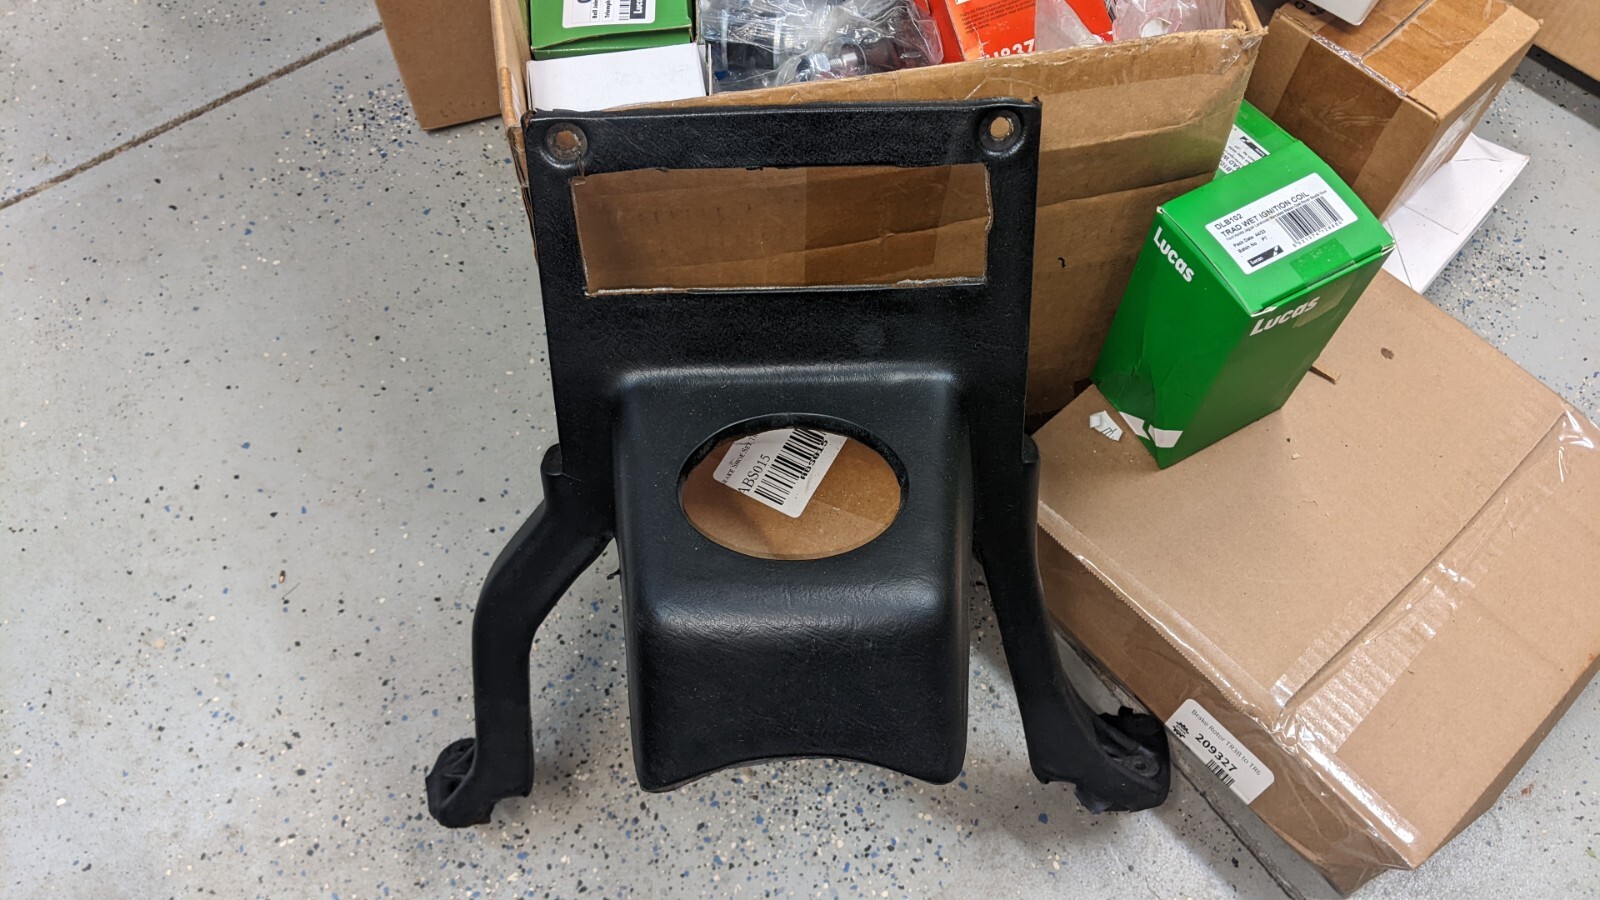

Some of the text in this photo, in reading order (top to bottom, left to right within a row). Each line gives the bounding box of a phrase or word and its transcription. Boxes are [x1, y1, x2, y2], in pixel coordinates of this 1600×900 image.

[1214, 214, 1243, 230] DLB102
[1221, 192, 1310, 238] TRAD WET IGNITION COIL
[1153, 226, 1194, 282] Lucas
[1250, 255, 1263, 265] Lucas
[1250, 297, 1320, 336] Lucas
[738, 454, 770, 493] ABS015
[801, 440, 828, 480] ABS015
[1192, 709, 1209, 726] Brake
[1209, 726, 1226, 742] Rotor
[1249, 763, 1261, 776] TR6
[1195, 733, 1237, 772] 209327
